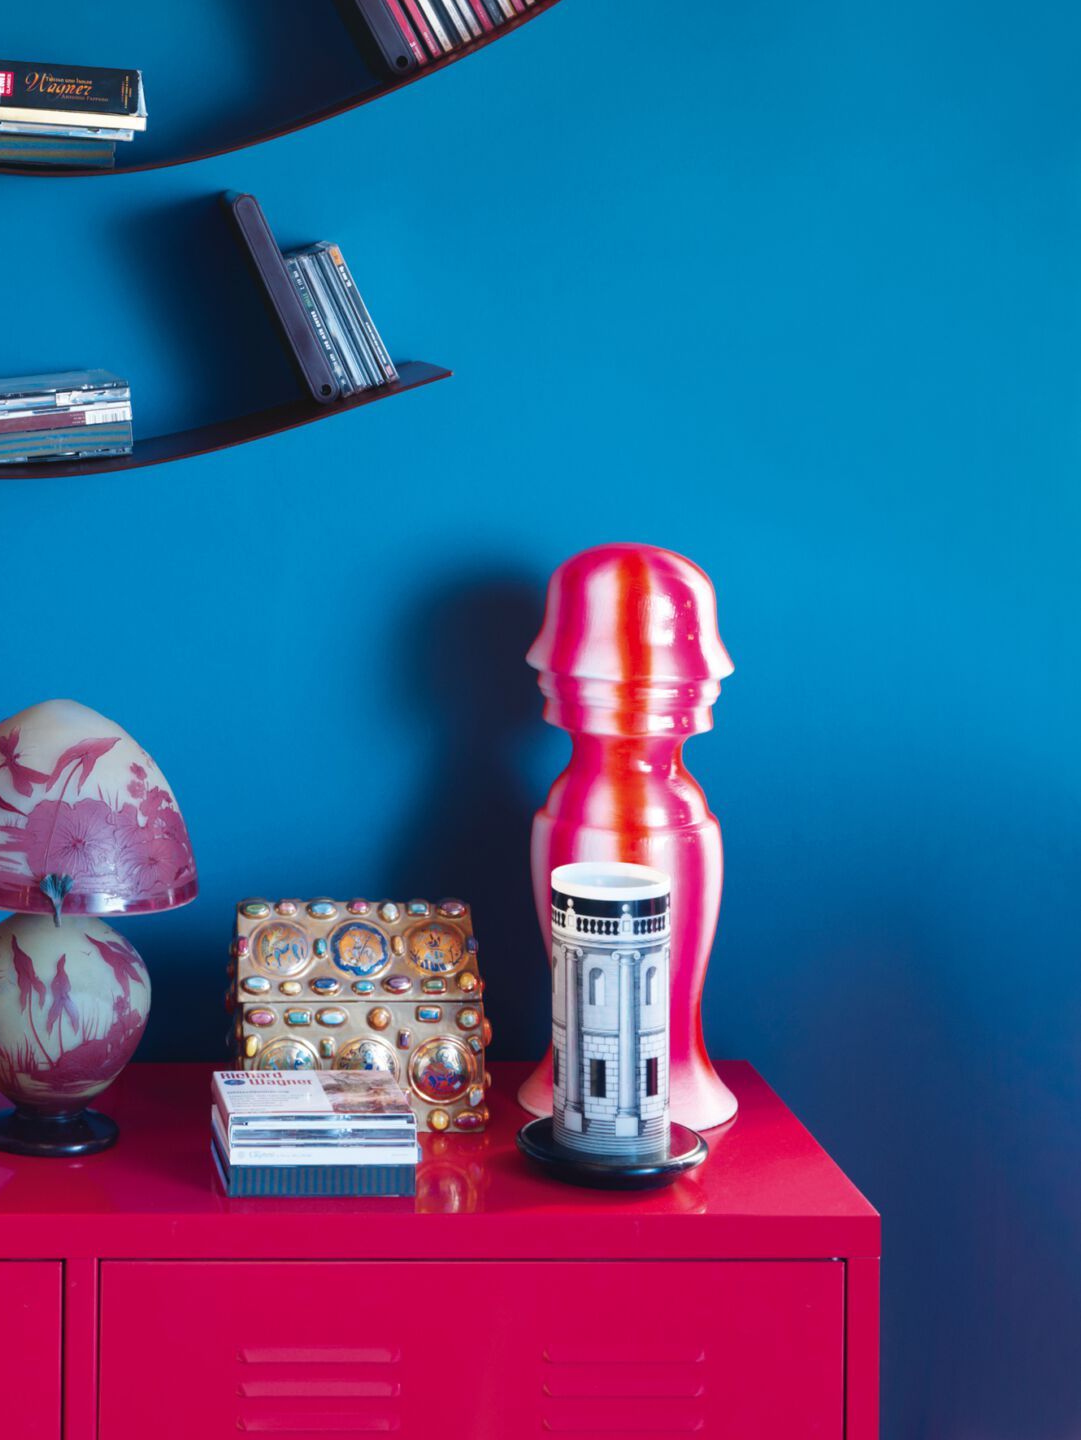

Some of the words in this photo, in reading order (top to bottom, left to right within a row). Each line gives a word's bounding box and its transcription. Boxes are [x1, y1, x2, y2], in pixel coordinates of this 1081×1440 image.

[24, 71, 93, 102] Wagner
[309, 310, 322, 328] BRAND
[317, 327, 327, 340] NEW
[322, 339, 332, 351] DAY
[219, 1071, 283, 1079] Richard
[248, 1078, 312, 1086] Wagner
